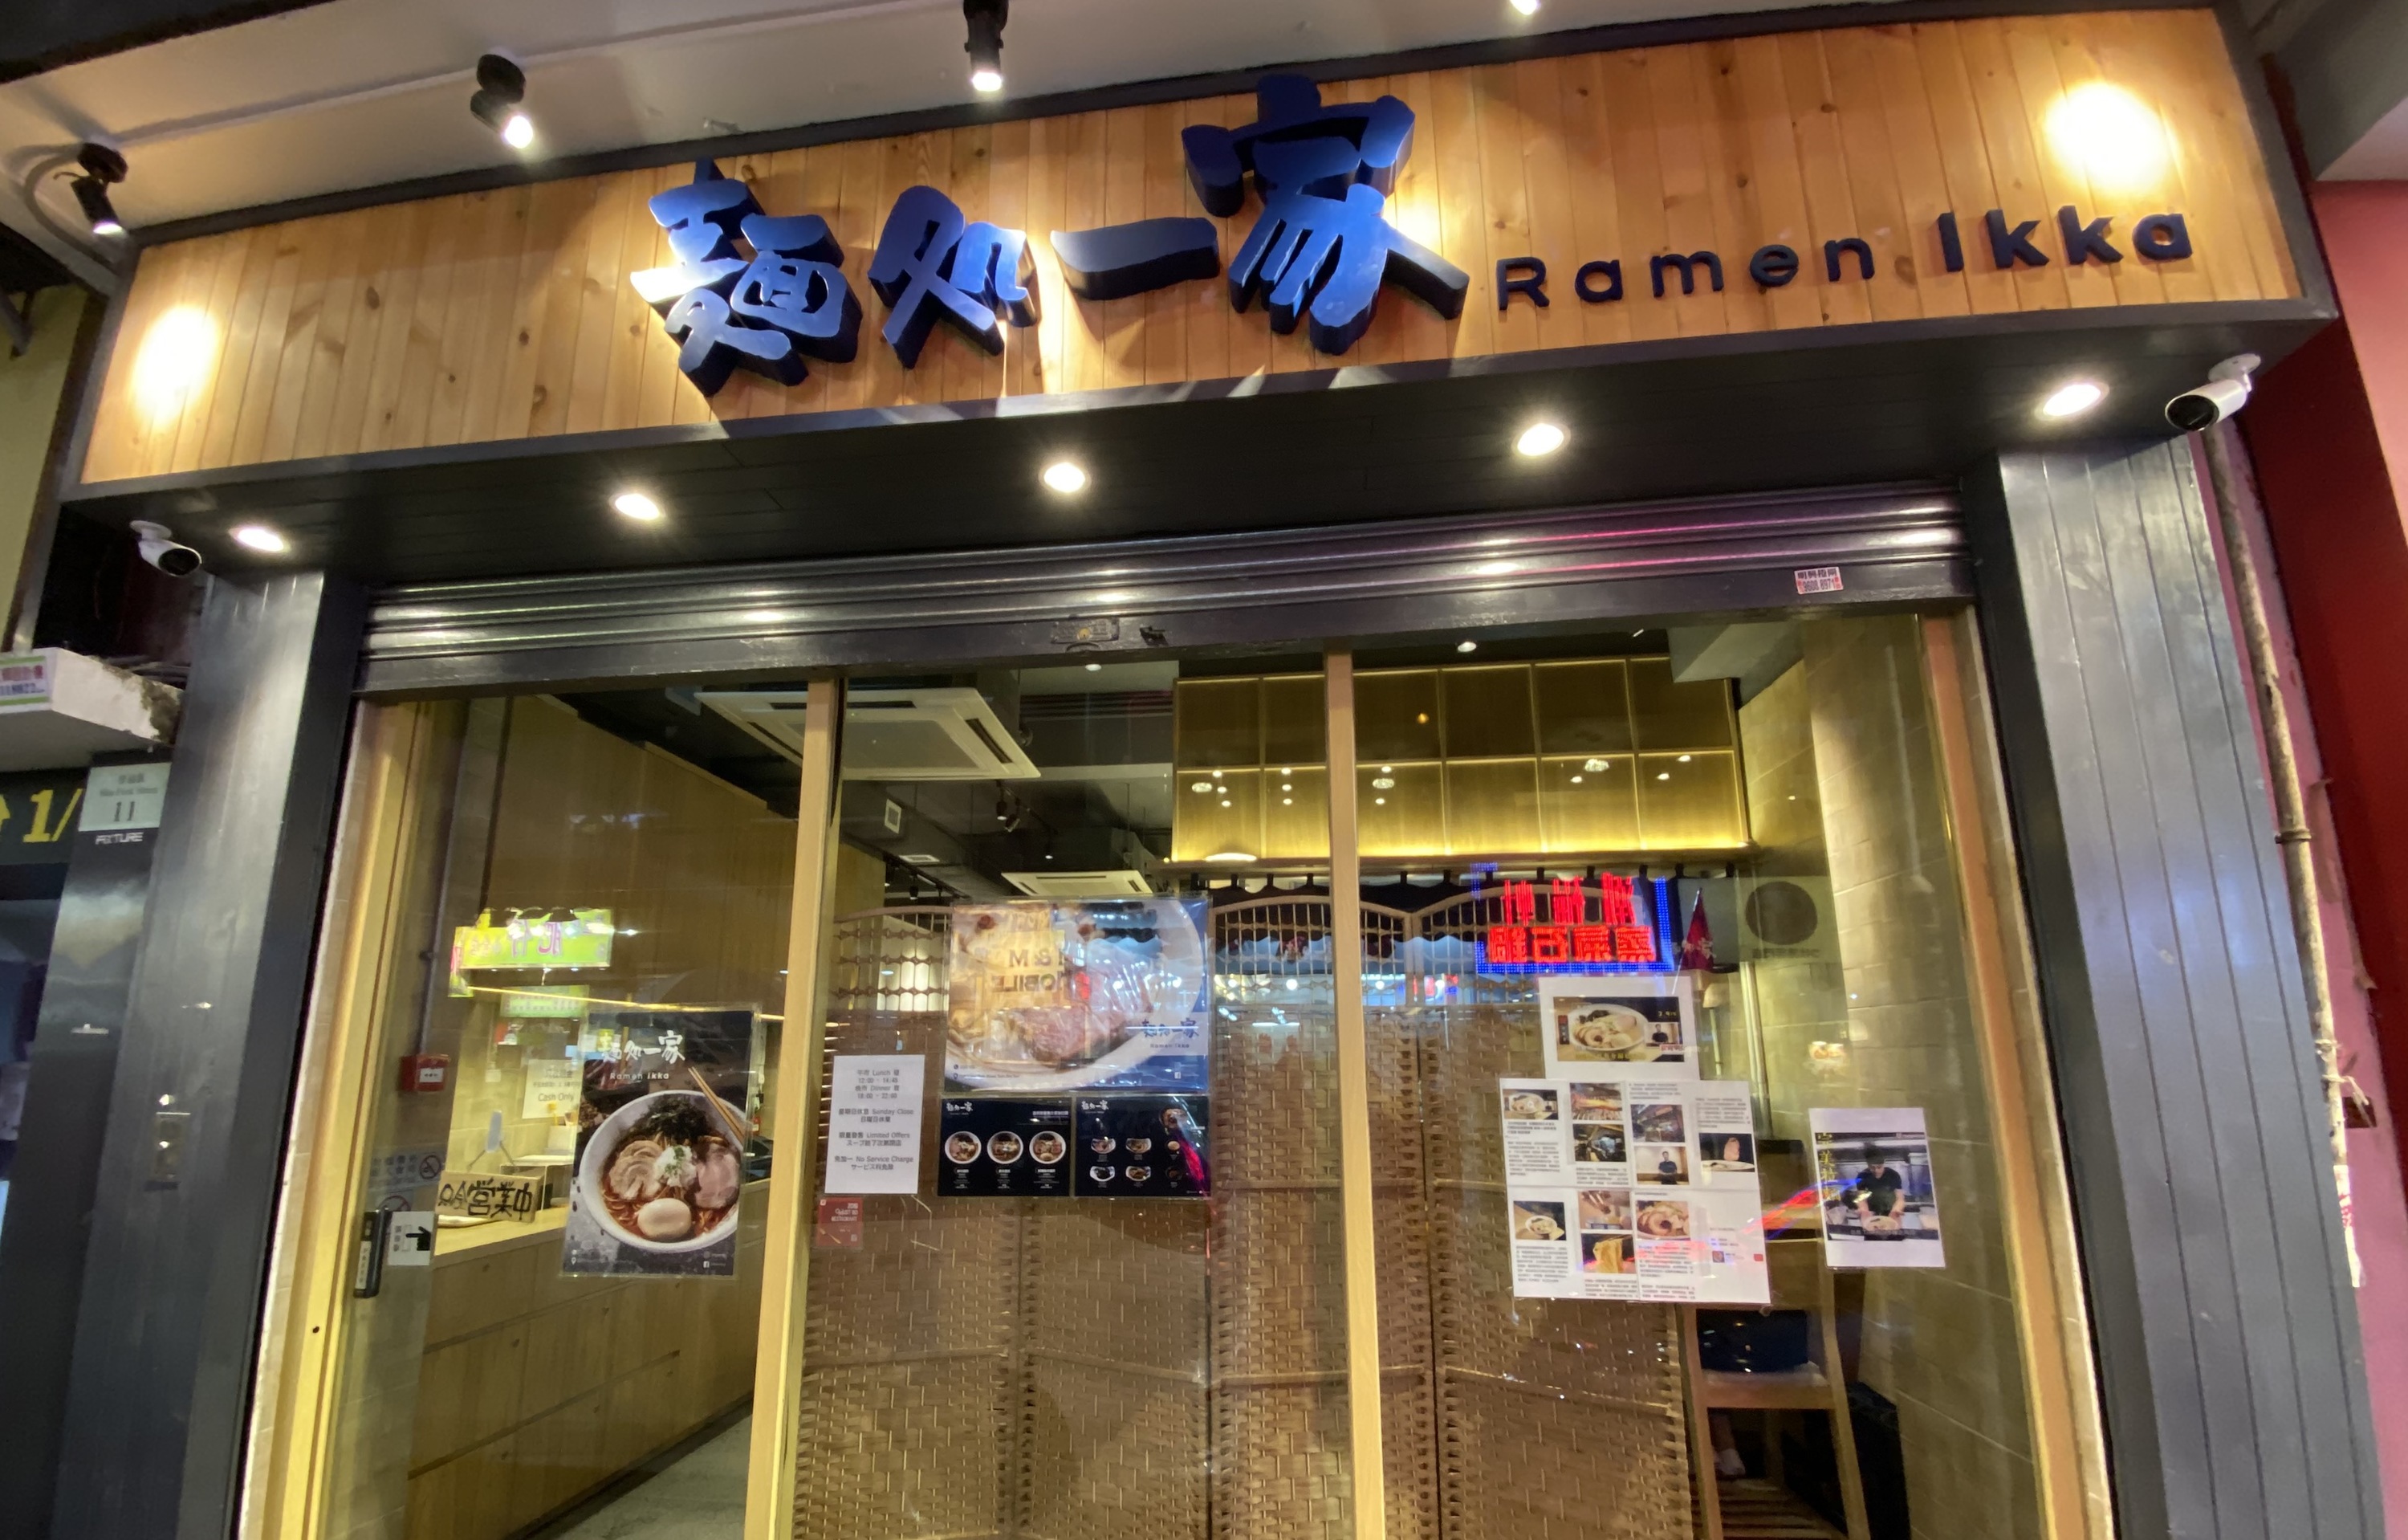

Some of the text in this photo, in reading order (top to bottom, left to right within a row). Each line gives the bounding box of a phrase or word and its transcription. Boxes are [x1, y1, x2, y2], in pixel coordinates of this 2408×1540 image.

[1497, 205, 2193, 311] Ramen Ikka
[610, 1072, 643, 1081] Ramen
[538, 1092, 574, 1102] Cash Only
